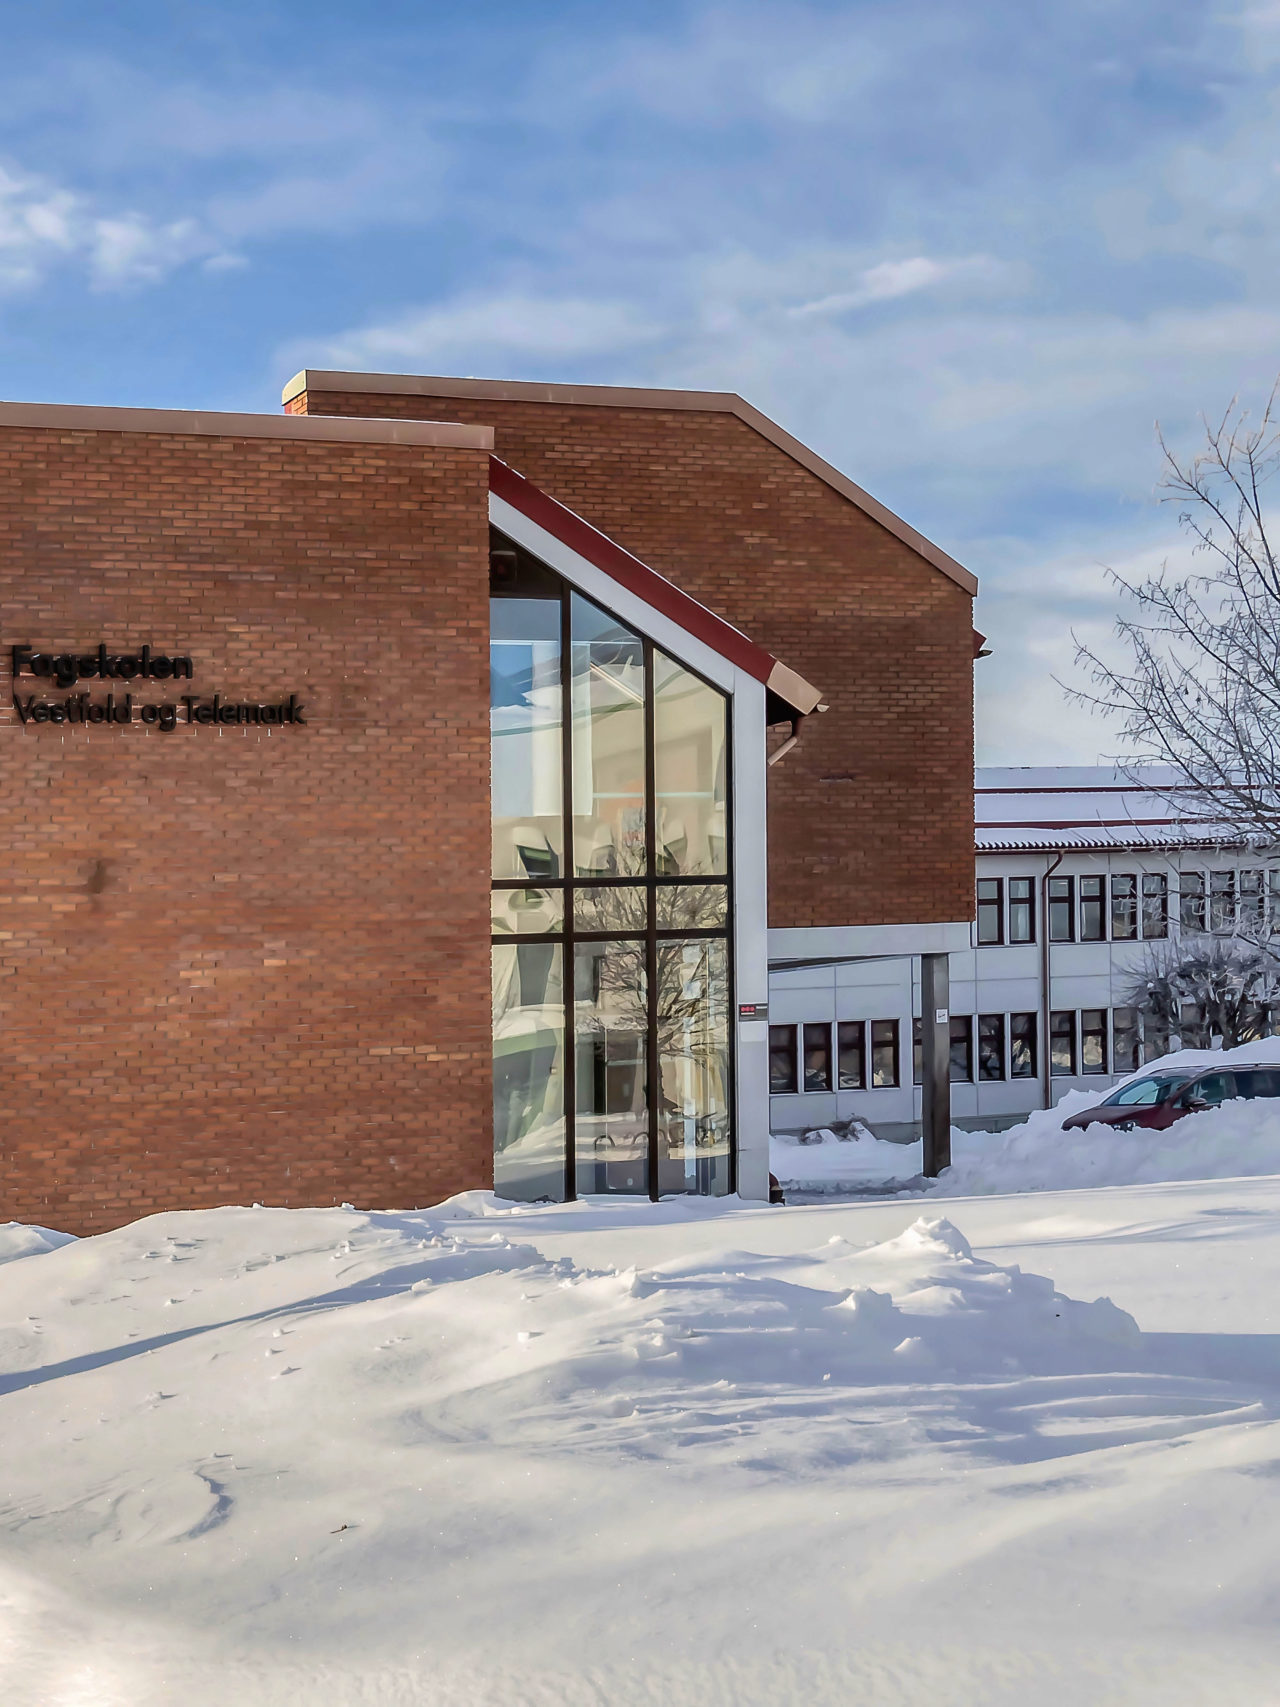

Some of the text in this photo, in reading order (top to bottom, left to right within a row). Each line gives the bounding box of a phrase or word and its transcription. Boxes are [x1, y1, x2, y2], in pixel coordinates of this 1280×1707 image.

[12, 644, 193, 688] Fagskolen
[13, 693, 307, 732] Vestfold og Telemark
